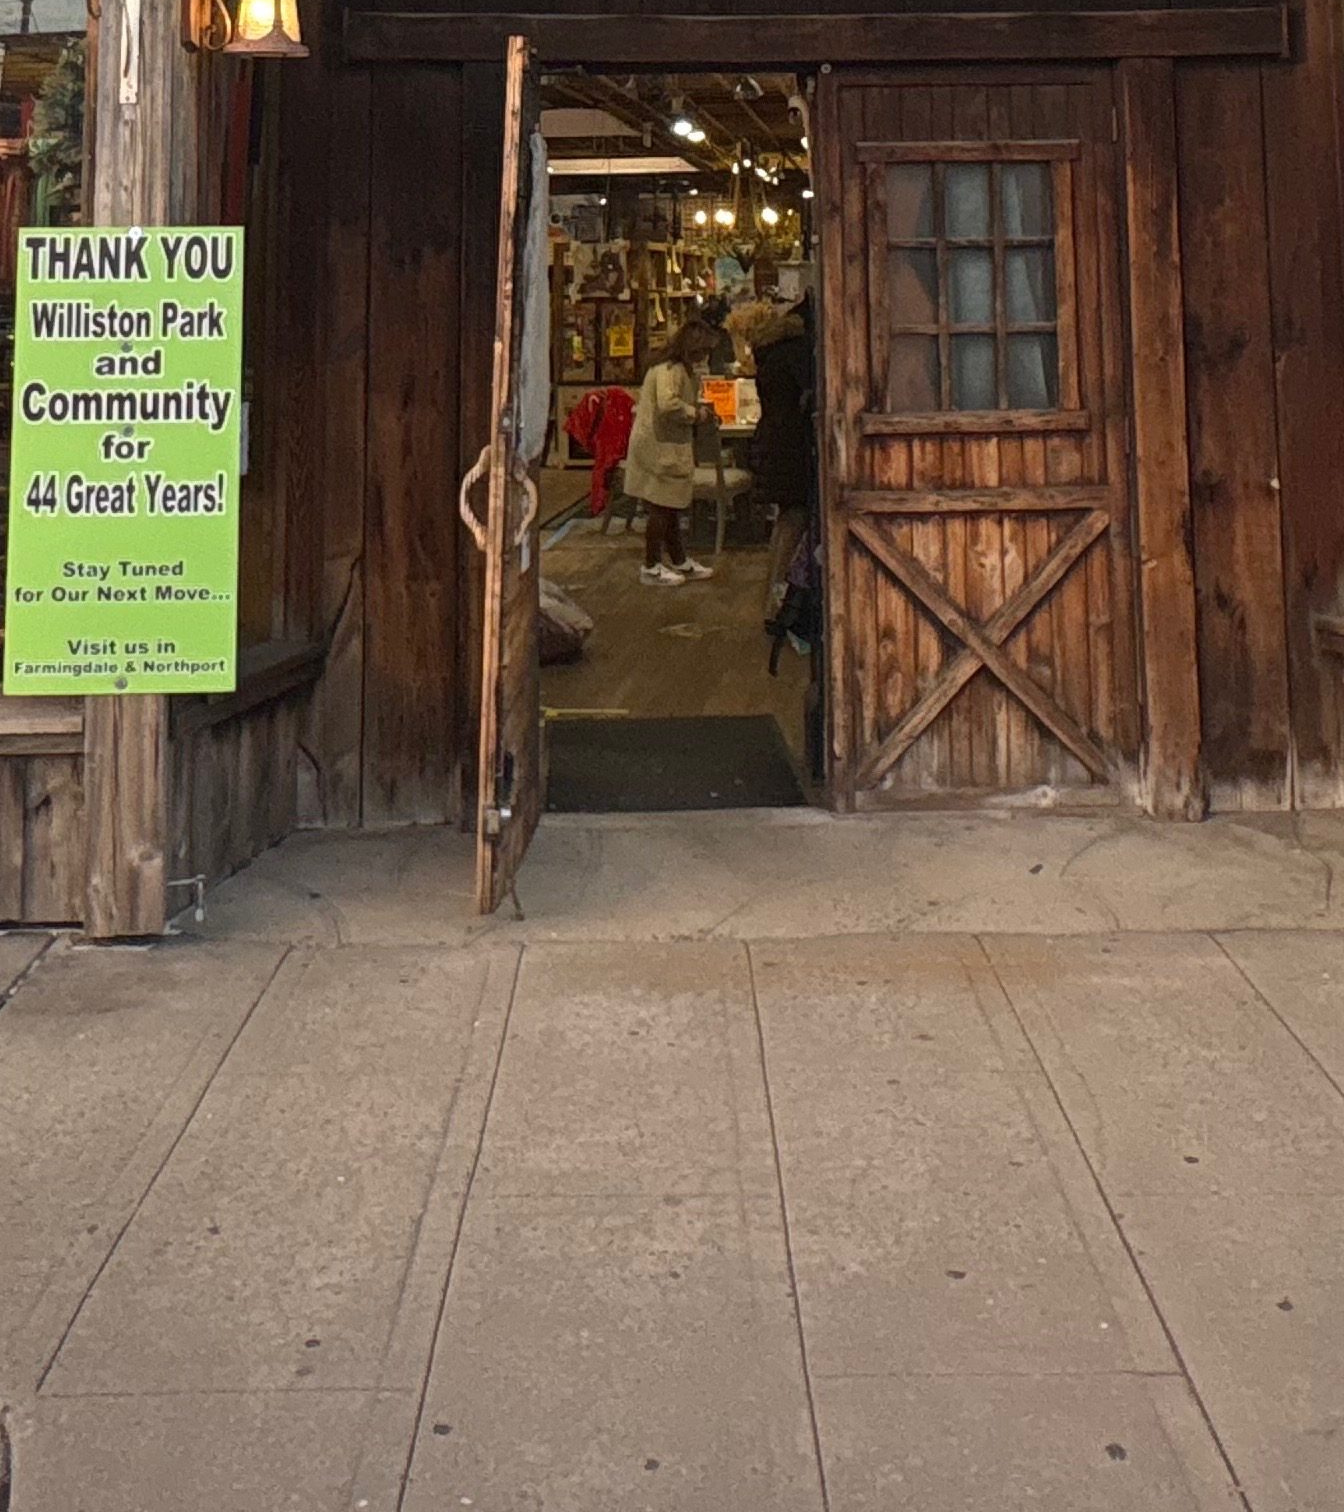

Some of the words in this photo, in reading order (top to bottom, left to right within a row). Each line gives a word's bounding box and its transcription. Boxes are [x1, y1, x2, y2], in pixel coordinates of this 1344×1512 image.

[26, 236, 147, 281] THANK
[160, 235, 234, 280] YOU
[32, 301, 150, 339] Williston
[161, 301, 224, 338] Park
[95, 349, 161, 376] and
[22, 382, 232, 430] Community
[102, 434, 150, 460] for
[27, 474, 57, 514] 44
[66, 474, 136, 514] Great
[145, 473, 224, 514] Years!
[62, 561, 111, 581] Stay
[118, 561, 184, 578] Tuned
[15, 587, 44, 603] for
[51, 587, 89, 603] Our
[97, 586, 147, 602] Next
[154, 585, 231, 602] Move...
[67, 639, 117, 656] Visit
[125, 642, 150, 656] us
[157, 639, 176, 655] in
[14, 661, 118, 676] Farmingdale
[125, 660, 137, 674] &
[143, 658, 226, 675] Northport
